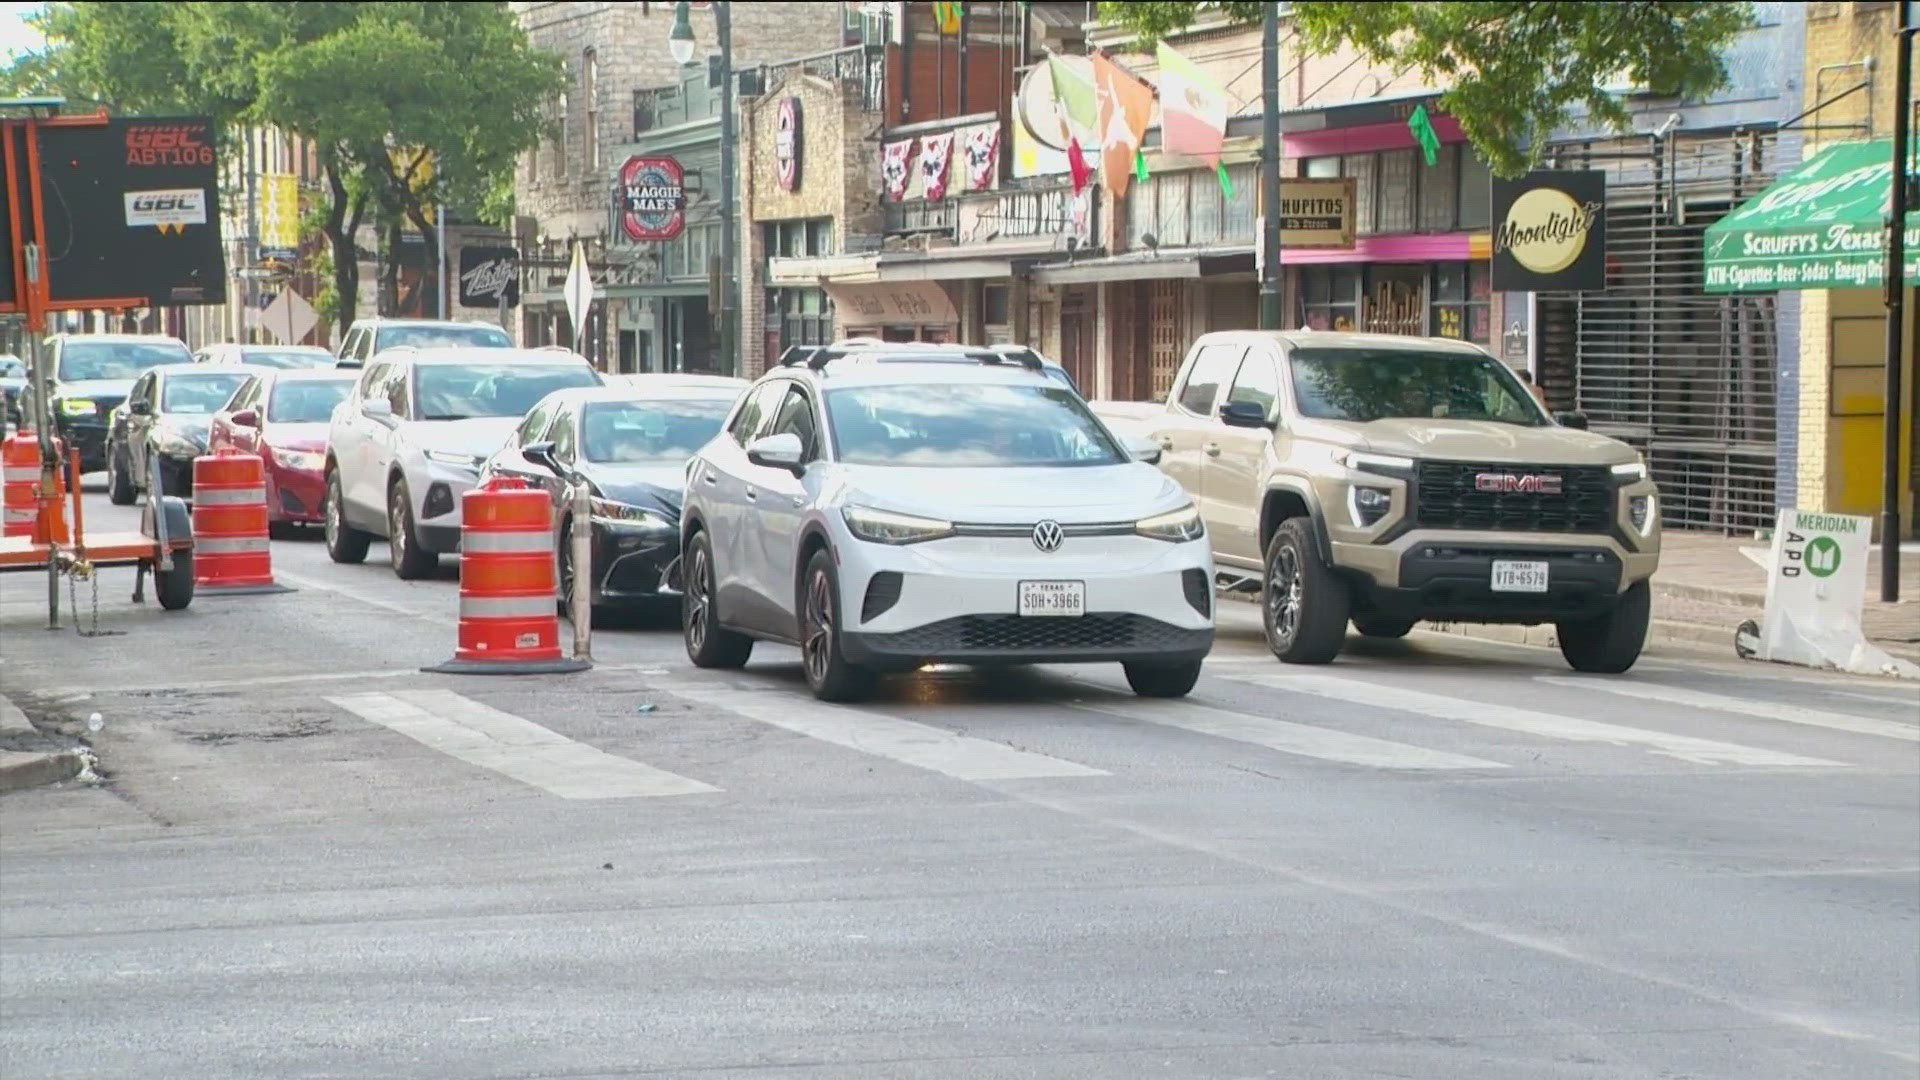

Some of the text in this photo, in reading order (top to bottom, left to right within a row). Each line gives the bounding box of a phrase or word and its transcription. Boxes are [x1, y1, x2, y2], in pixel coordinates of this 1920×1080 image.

[627, 187, 682, 198] MAGGIE
[633, 199, 676, 210] MAE'S
[999, 191, 1063, 236] BLIND PIG
[1281, 199, 1343, 215] HUPITOS
[1495, 201, 1603, 254] Moonlight
[1743, 232, 1819, 255] SCRUFFY'S
[1823, 223, 1882, 251] Texas
[1706, 266, 1727, 285] ATM
[1729, 265, 1774, 289] Cigarettes
[1777, 263, 1797, 282] Beer
[1801, 262, 1829, 281] Sodas
[1835, 260, 1867, 285] Energy
[1475, 473, 1562, 494] GMC
[1795, 513, 1858, 533] MERIDIAN
[1782, 531, 1805, 577] APD
